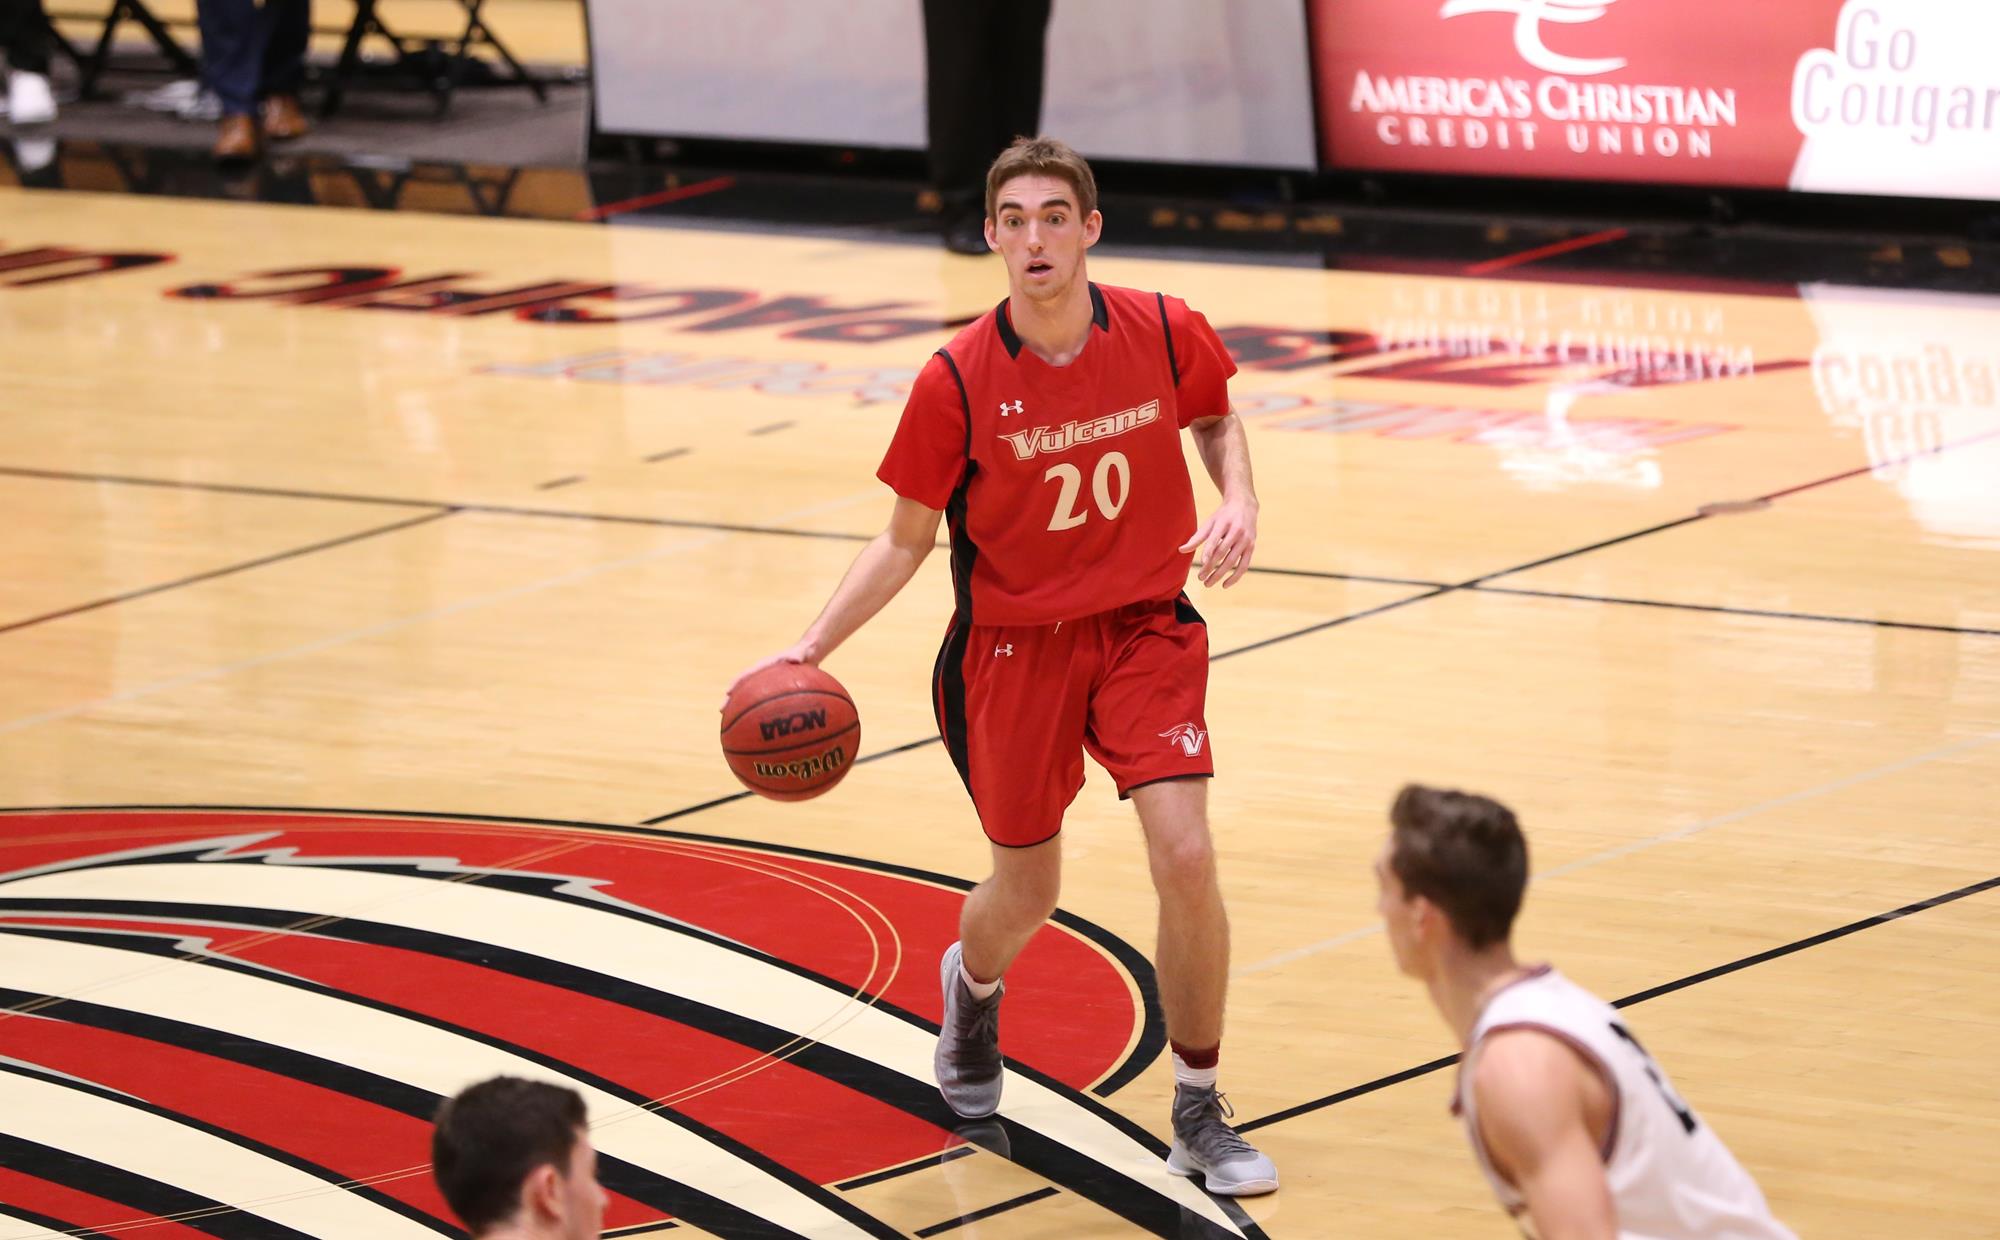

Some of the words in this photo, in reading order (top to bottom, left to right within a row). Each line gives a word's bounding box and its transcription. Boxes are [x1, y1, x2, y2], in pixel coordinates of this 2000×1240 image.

[1846, 8, 1917, 72] Go
[1350, 69, 1532, 119] AMERICA'S
[1536, 76, 1736, 127] CHRISTIAN
[1377, 115, 1537, 151] CREDIT
[1566, 123, 1712, 158] UNION
[998, 399, 1160, 460] Vulcans
[1044, 451, 1131, 531] 20
[759, 708, 827, 741] NCAA
[754, 746, 845, 779] Wilson
